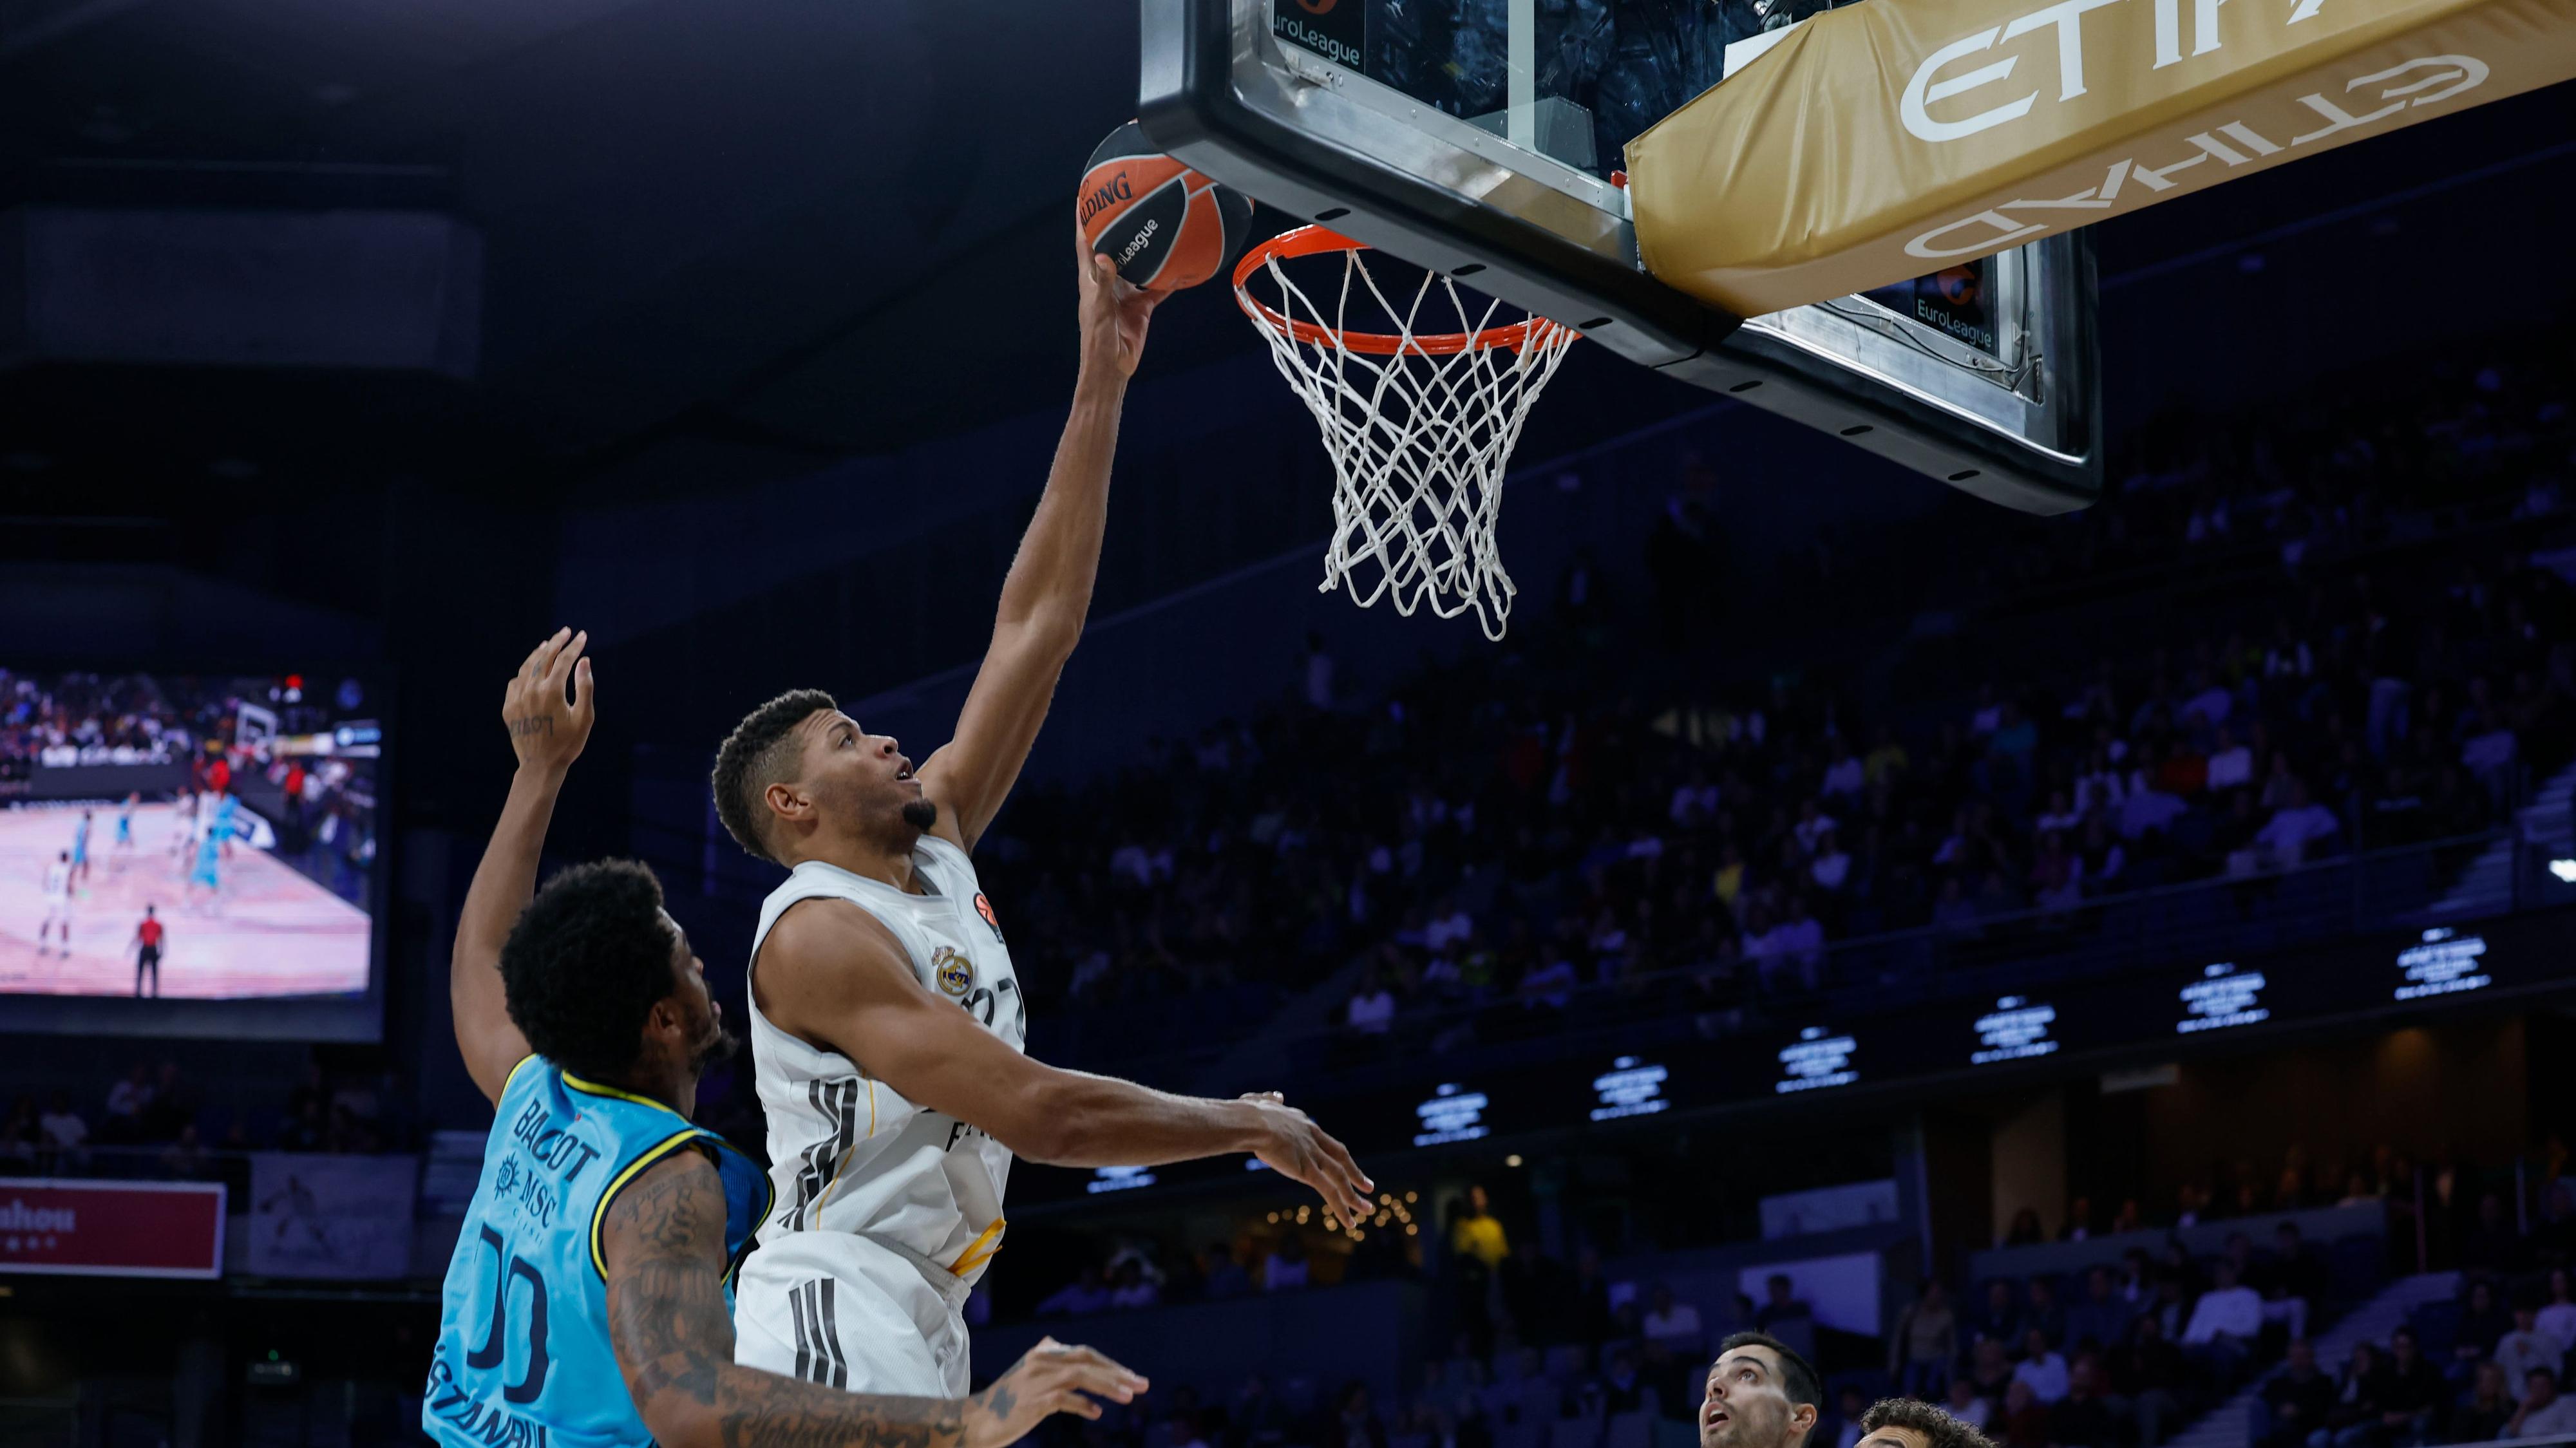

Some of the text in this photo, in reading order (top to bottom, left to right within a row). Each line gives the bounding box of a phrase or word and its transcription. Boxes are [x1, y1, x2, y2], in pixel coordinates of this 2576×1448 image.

[1904, 54, 2490, 258] ETIHAD
[1918, 298, 1991, 348] EuroLeague
[514, 1097, 601, 1183] BACOT
[519, 1169, 557, 1228] MSC
